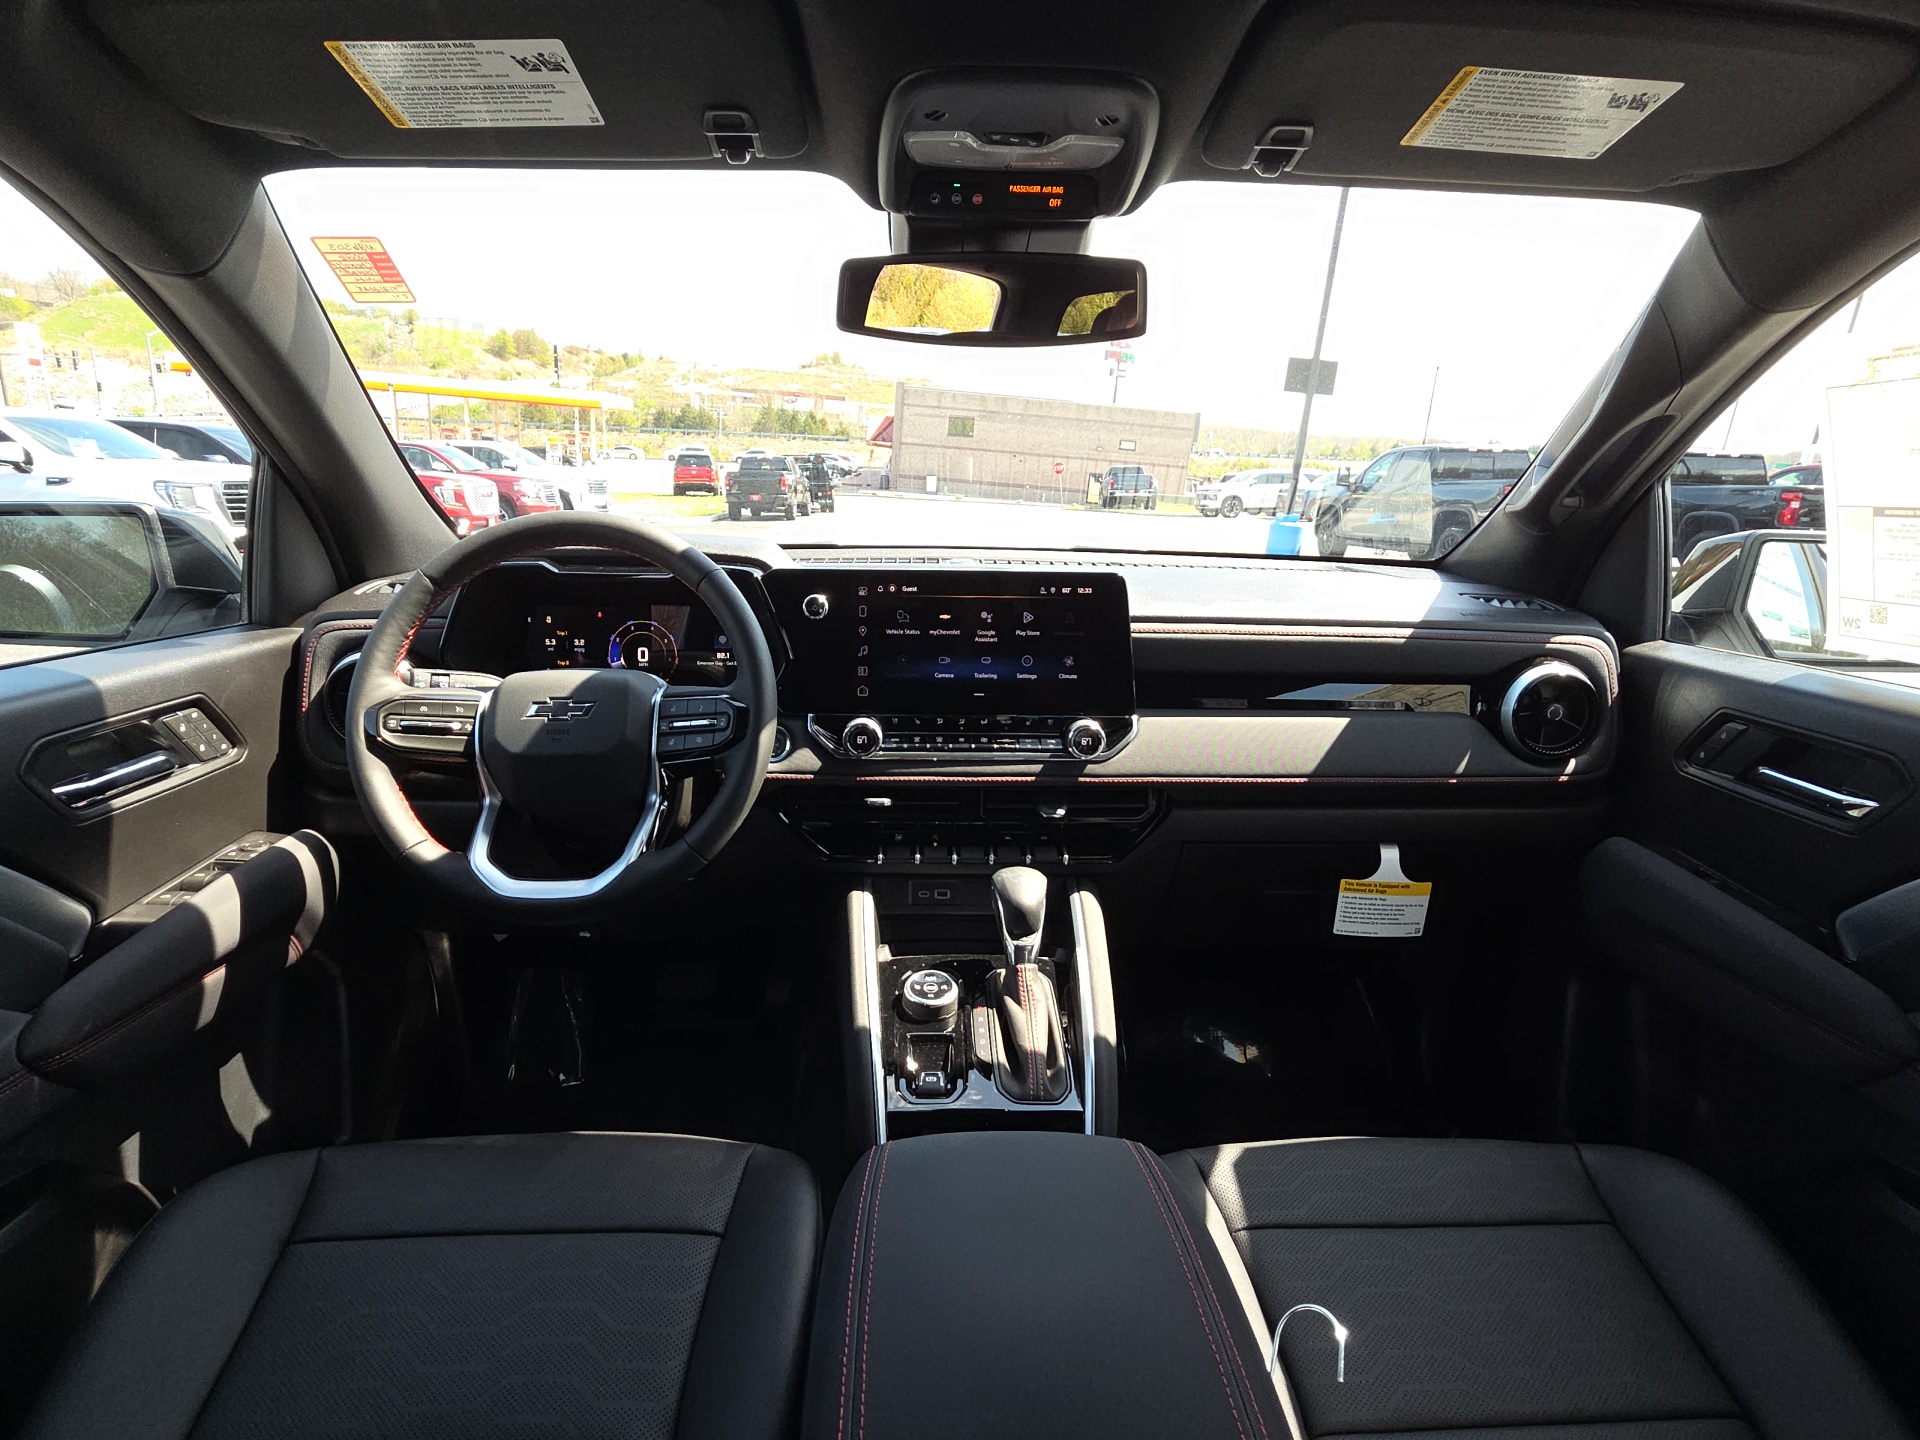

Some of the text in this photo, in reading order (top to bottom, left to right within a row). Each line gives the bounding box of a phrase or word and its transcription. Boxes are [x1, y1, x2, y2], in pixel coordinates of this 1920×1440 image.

[1521, 72, 1563, 80] ADVANCED
[1010, 185, 1041, 193] PASSENGER
[1052, 186, 1064, 194] BAG
[1049, 198, 1062, 207] OFF
[545, 638, 556, 646] 5.3
[574, 638, 585, 646] 3.2
[637, 647, 649, 662] 0
[857, 736, 868, 744] 67
[1081, 738, 1092, 746] 67
